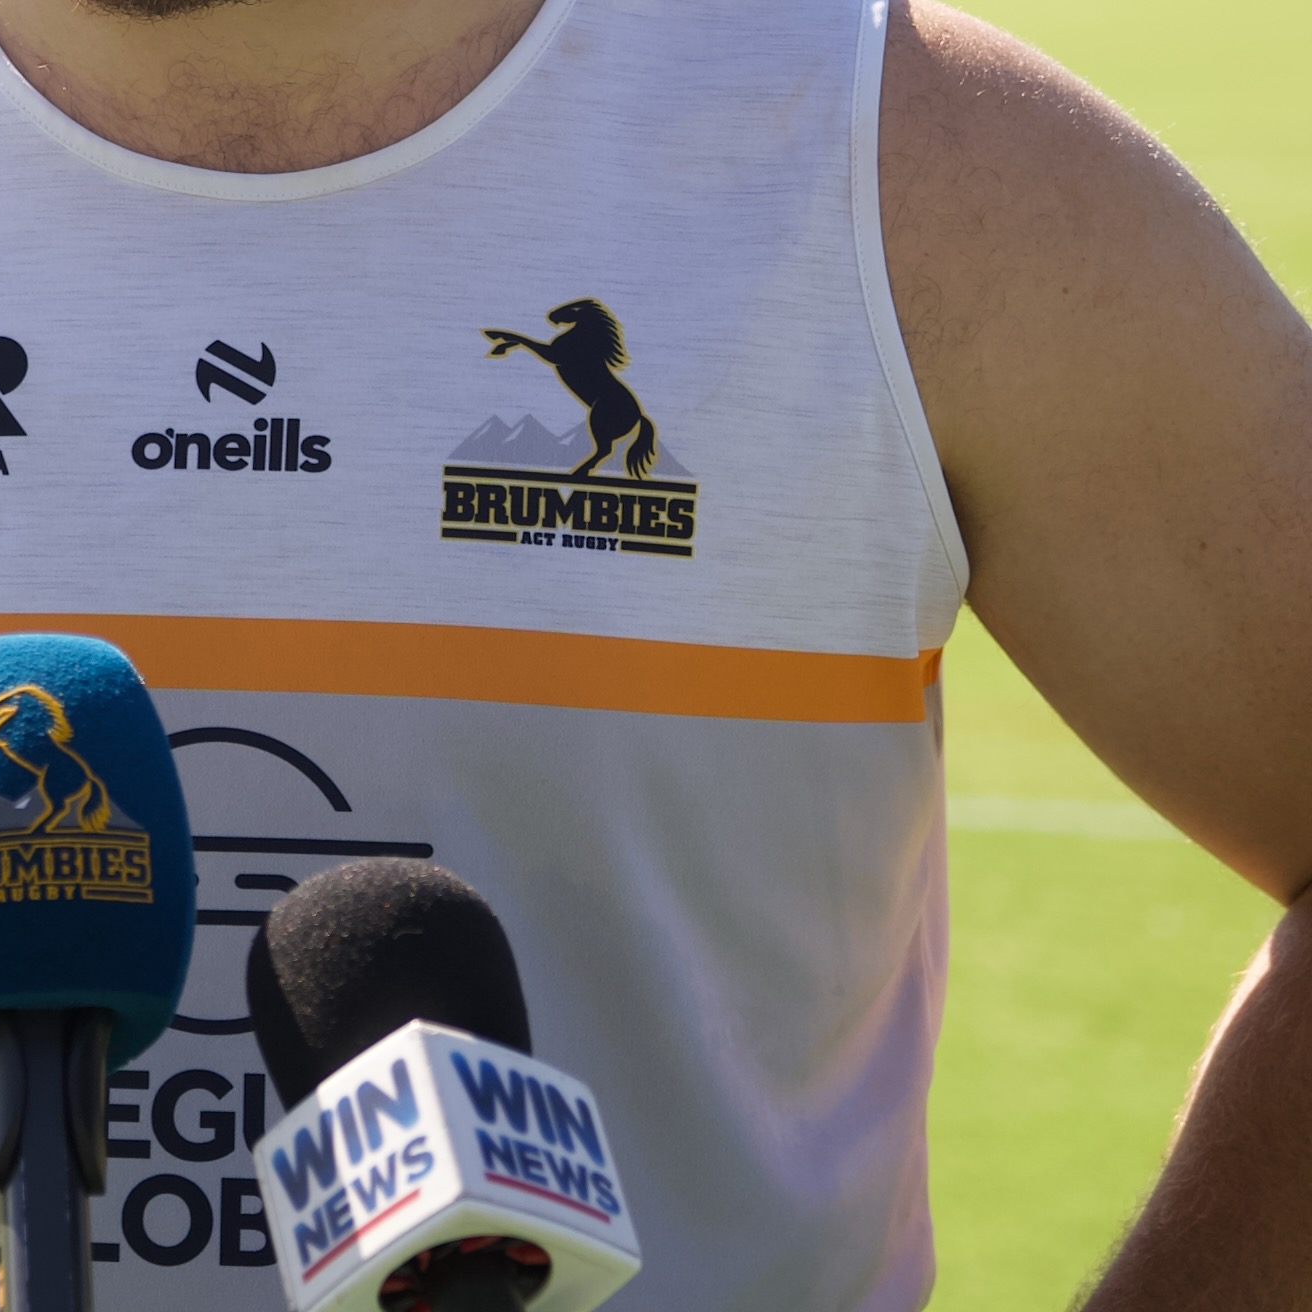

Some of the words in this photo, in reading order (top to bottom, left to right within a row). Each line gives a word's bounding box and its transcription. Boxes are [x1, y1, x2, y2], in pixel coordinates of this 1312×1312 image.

[442, 481, 695, 539] BRUMBIES
[520, 531, 556, 546] ACT
[561, 534, 619, 551] RUGBY
[271, 1058, 419, 1212] WIN
[449, 1050, 605, 1167] WIN
[294, 1135, 435, 1267] NEWS
[475, 1128, 621, 1216] NEWS
